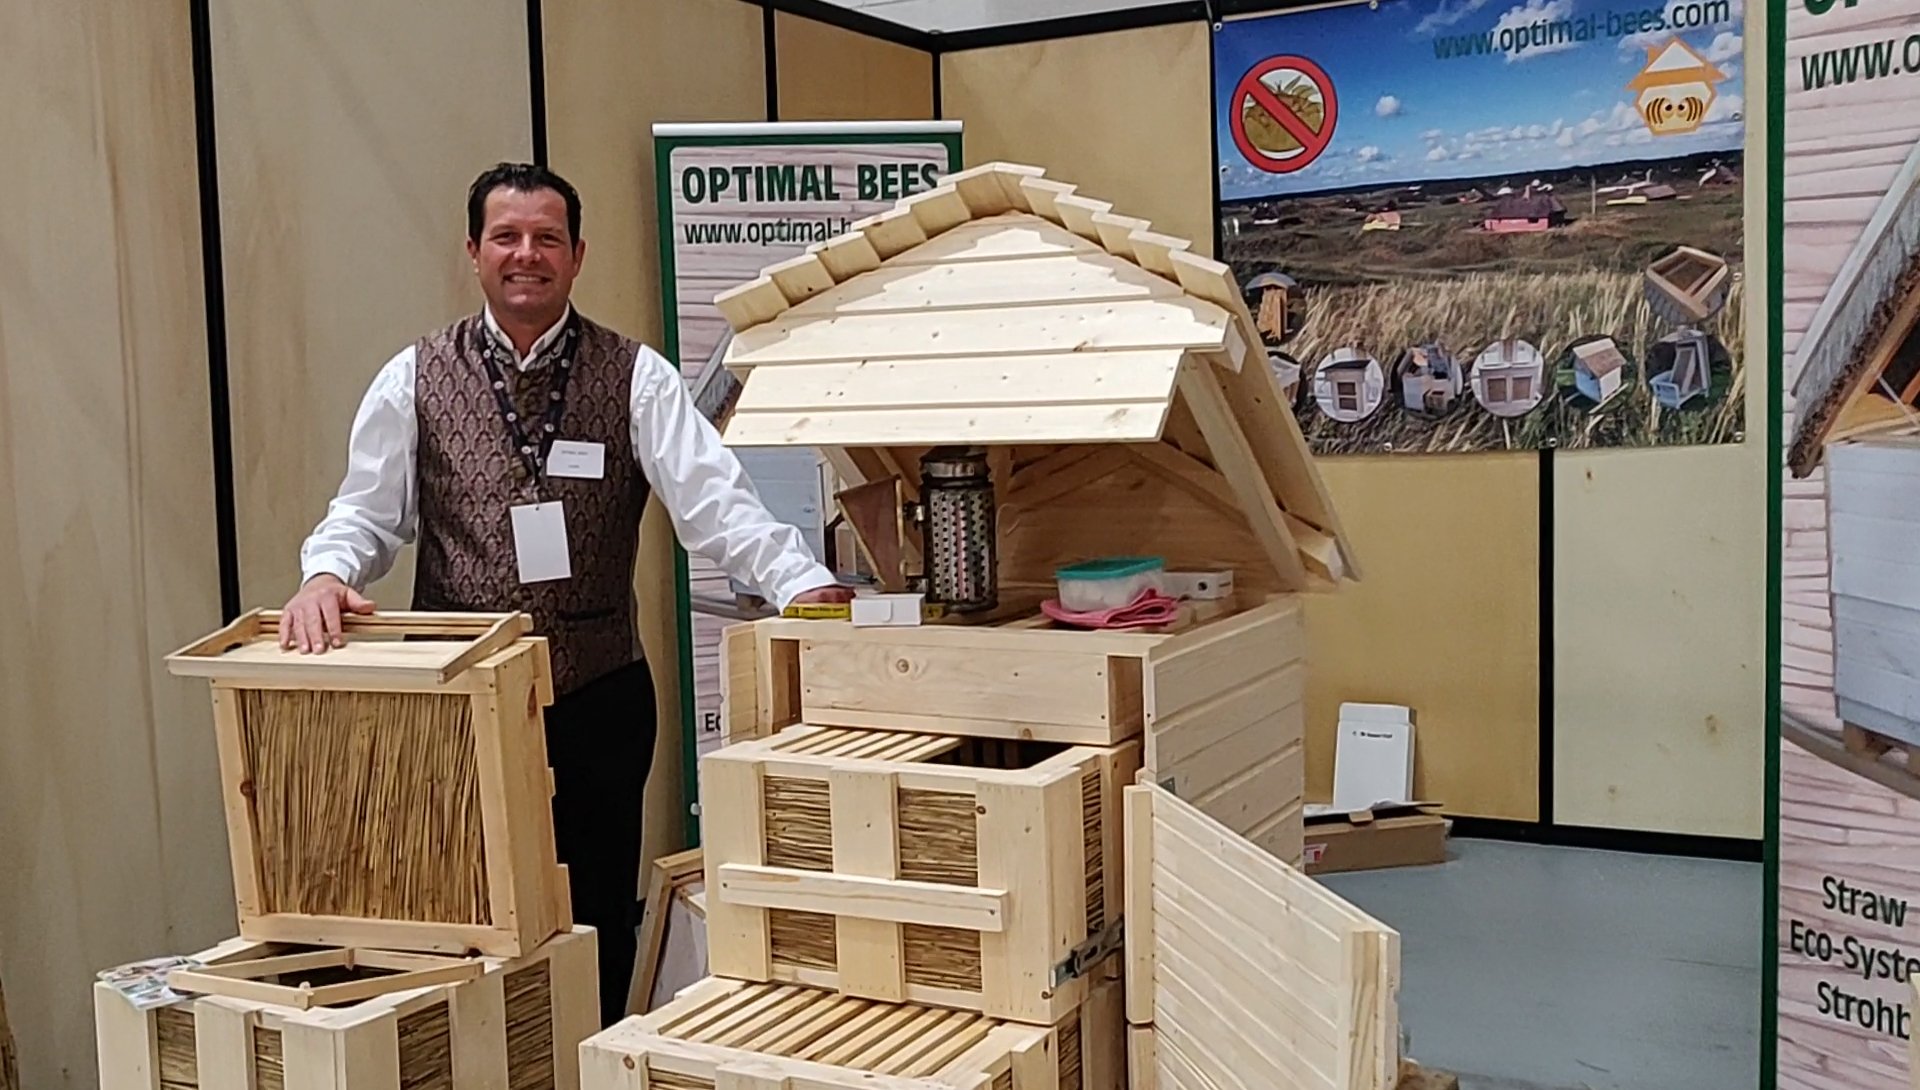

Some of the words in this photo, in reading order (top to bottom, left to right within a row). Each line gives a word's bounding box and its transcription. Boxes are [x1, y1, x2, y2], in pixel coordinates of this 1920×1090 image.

[1433, 0, 1729, 59] www.optimal-bees.com
[682, 164, 840, 204] OPTIMAL
[857, 163, 939, 200] BEES
[1822, 876, 1907, 927] Straw
